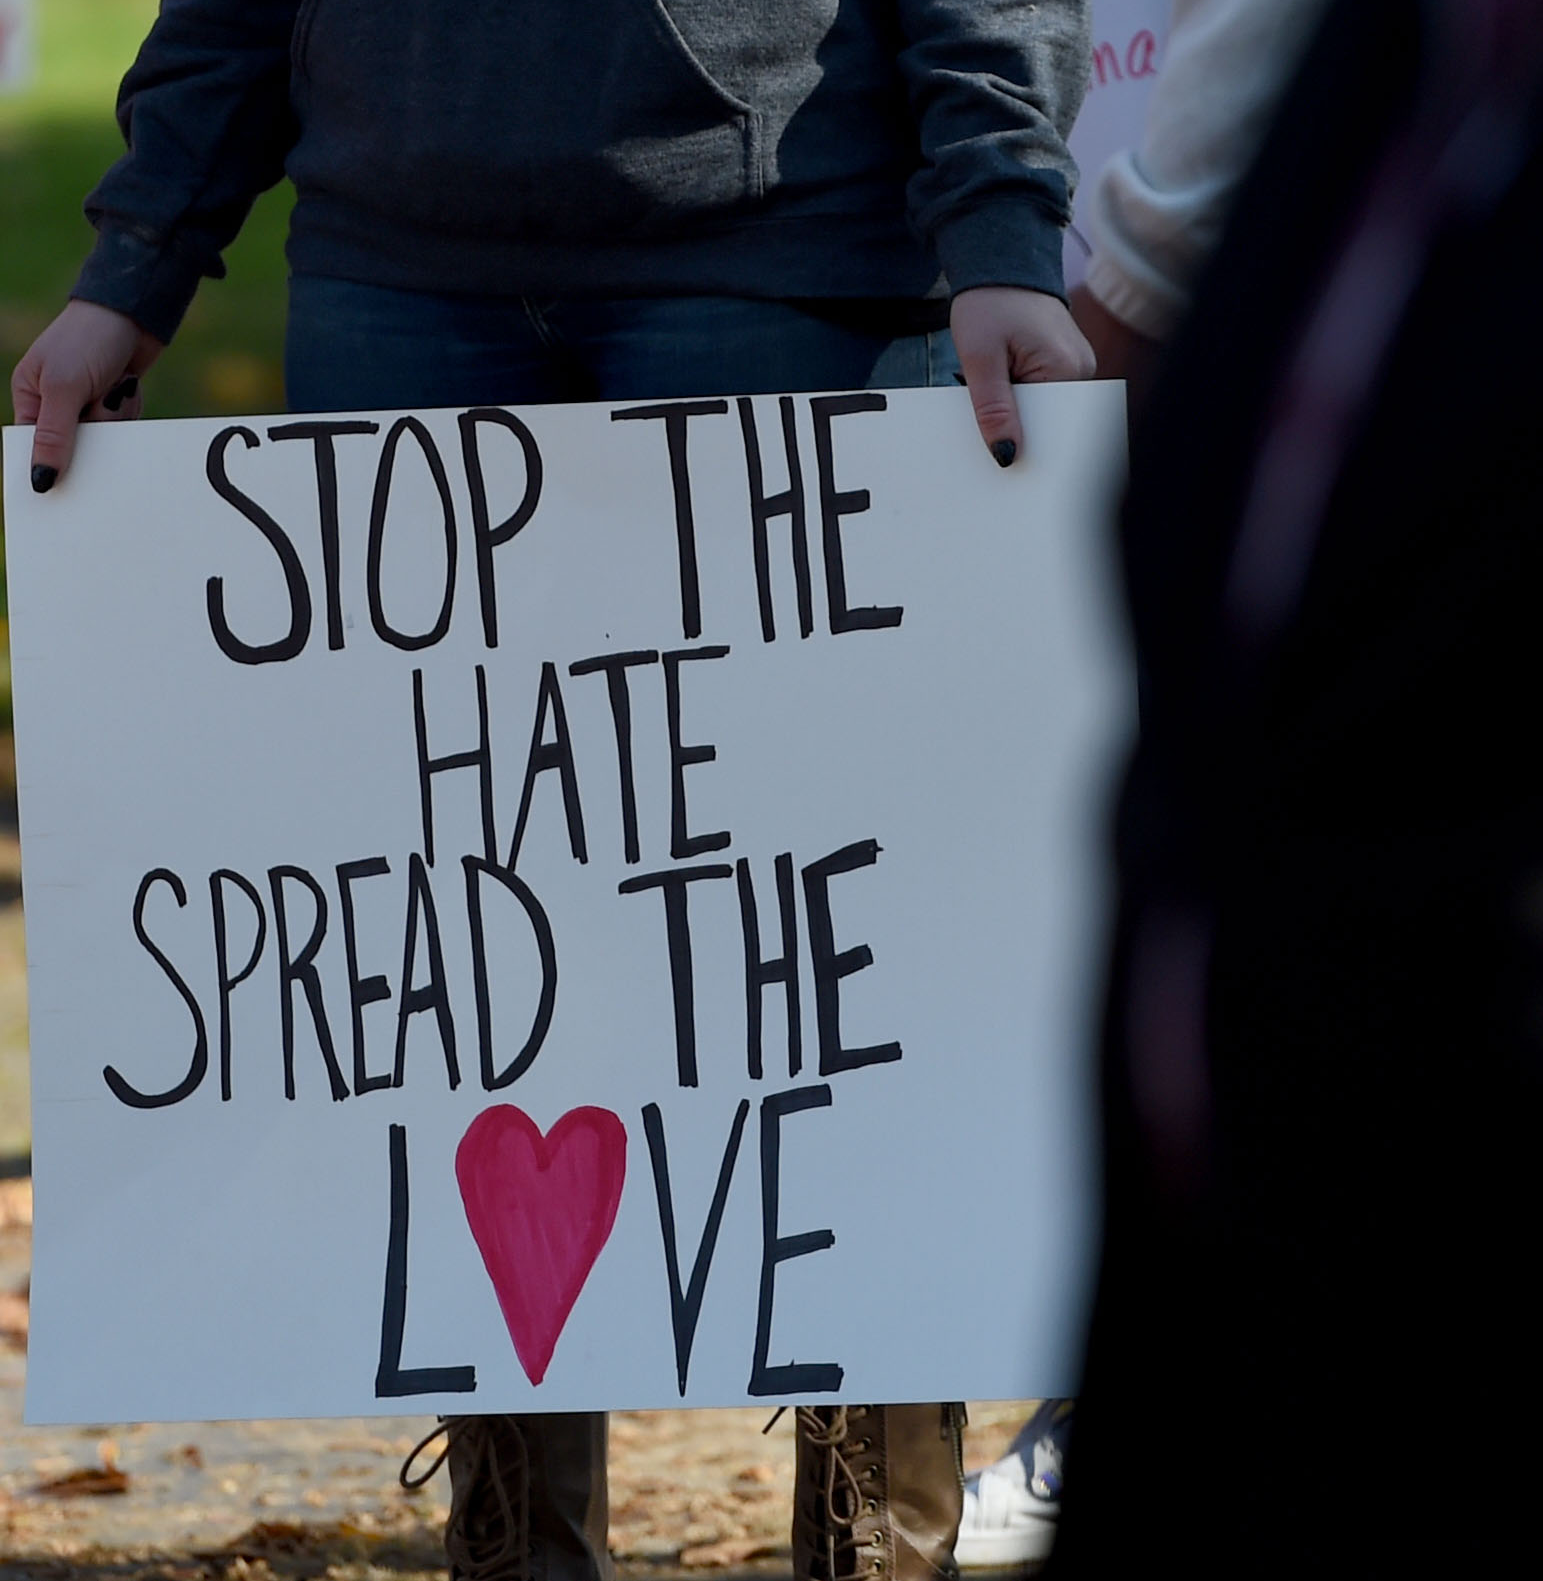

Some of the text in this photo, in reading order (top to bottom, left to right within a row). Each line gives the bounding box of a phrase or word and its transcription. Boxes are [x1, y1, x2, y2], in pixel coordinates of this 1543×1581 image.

[206, 393, 904, 665] STOP THE
[412, 646, 732, 869] HATE
[102, 839, 903, 1109] SPREAD THE
